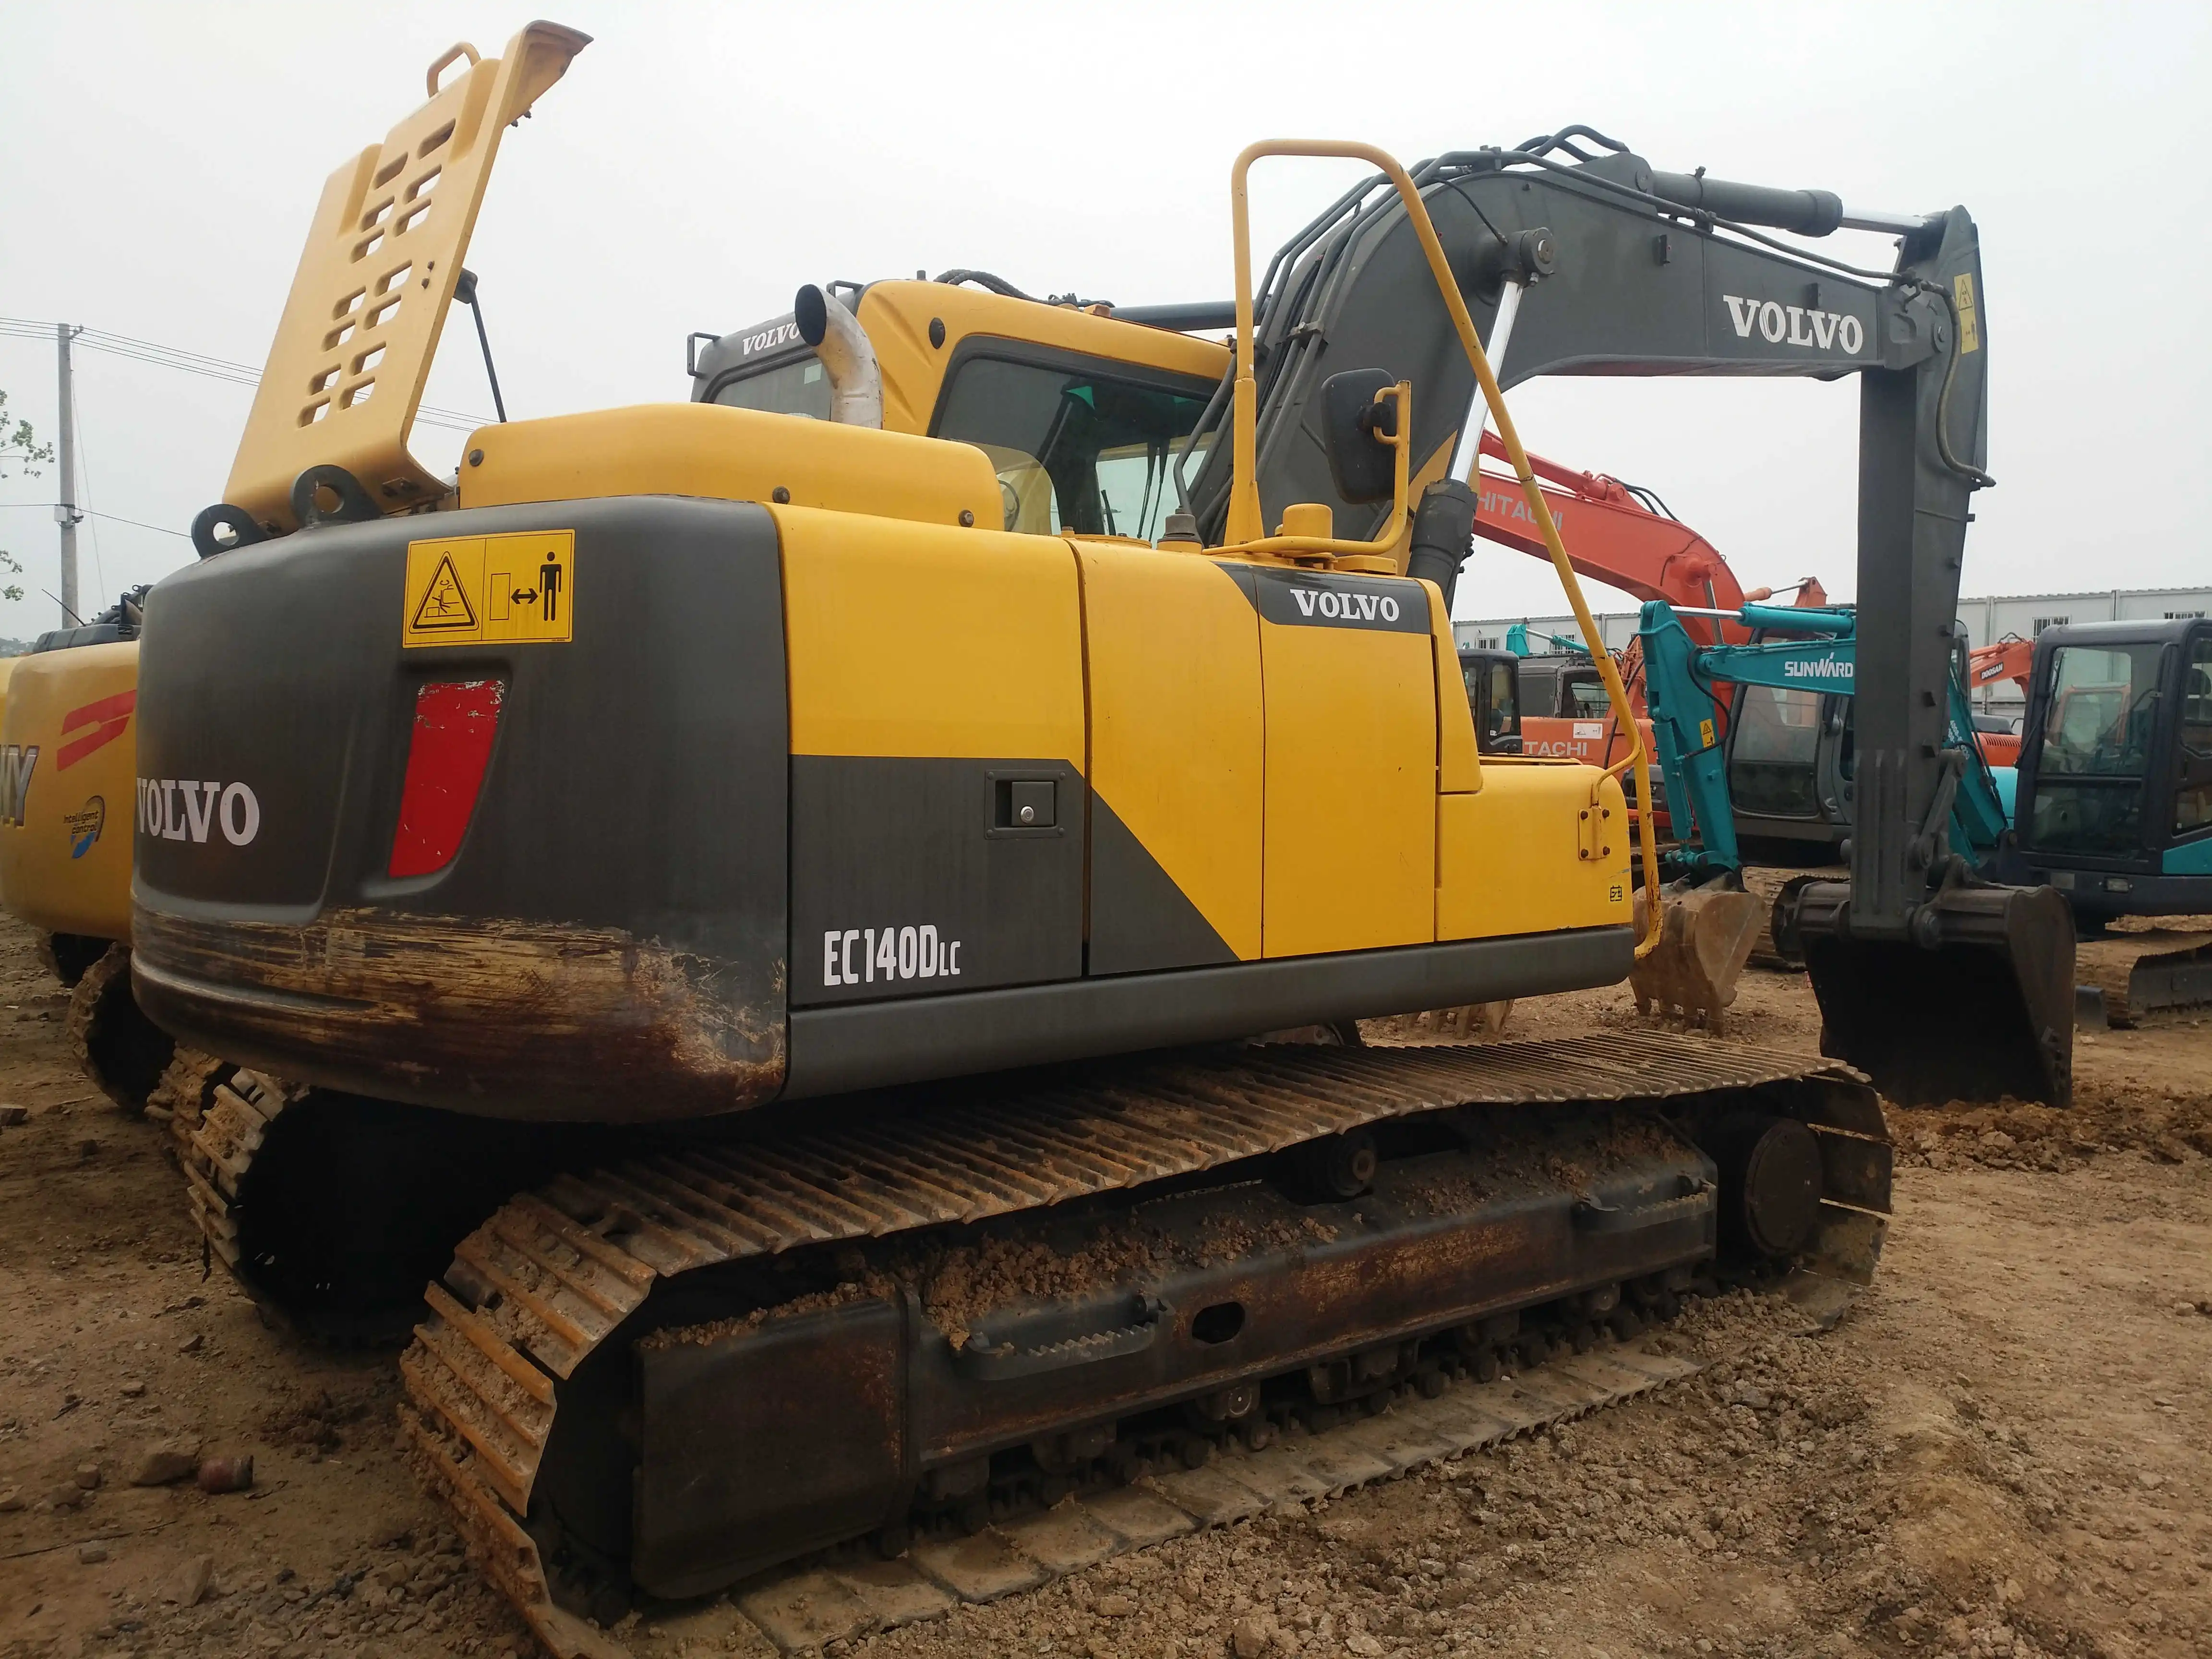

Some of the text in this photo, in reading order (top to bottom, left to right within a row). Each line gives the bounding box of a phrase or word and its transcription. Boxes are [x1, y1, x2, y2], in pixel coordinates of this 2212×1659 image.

[742, 322, 800, 355] VOLVO
[1723, 294, 1863, 355] VOLVO
[1289, 589, 1399, 622] VOLVO
[1784, 652, 1853, 677] SUNWARD
[1981, 663, 2003, 680] DOOSAN
[1524, 741, 1587, 757] TACHI
[0, 744, 40, 829] NY
[137, 777, 260, 846] VOLVO
